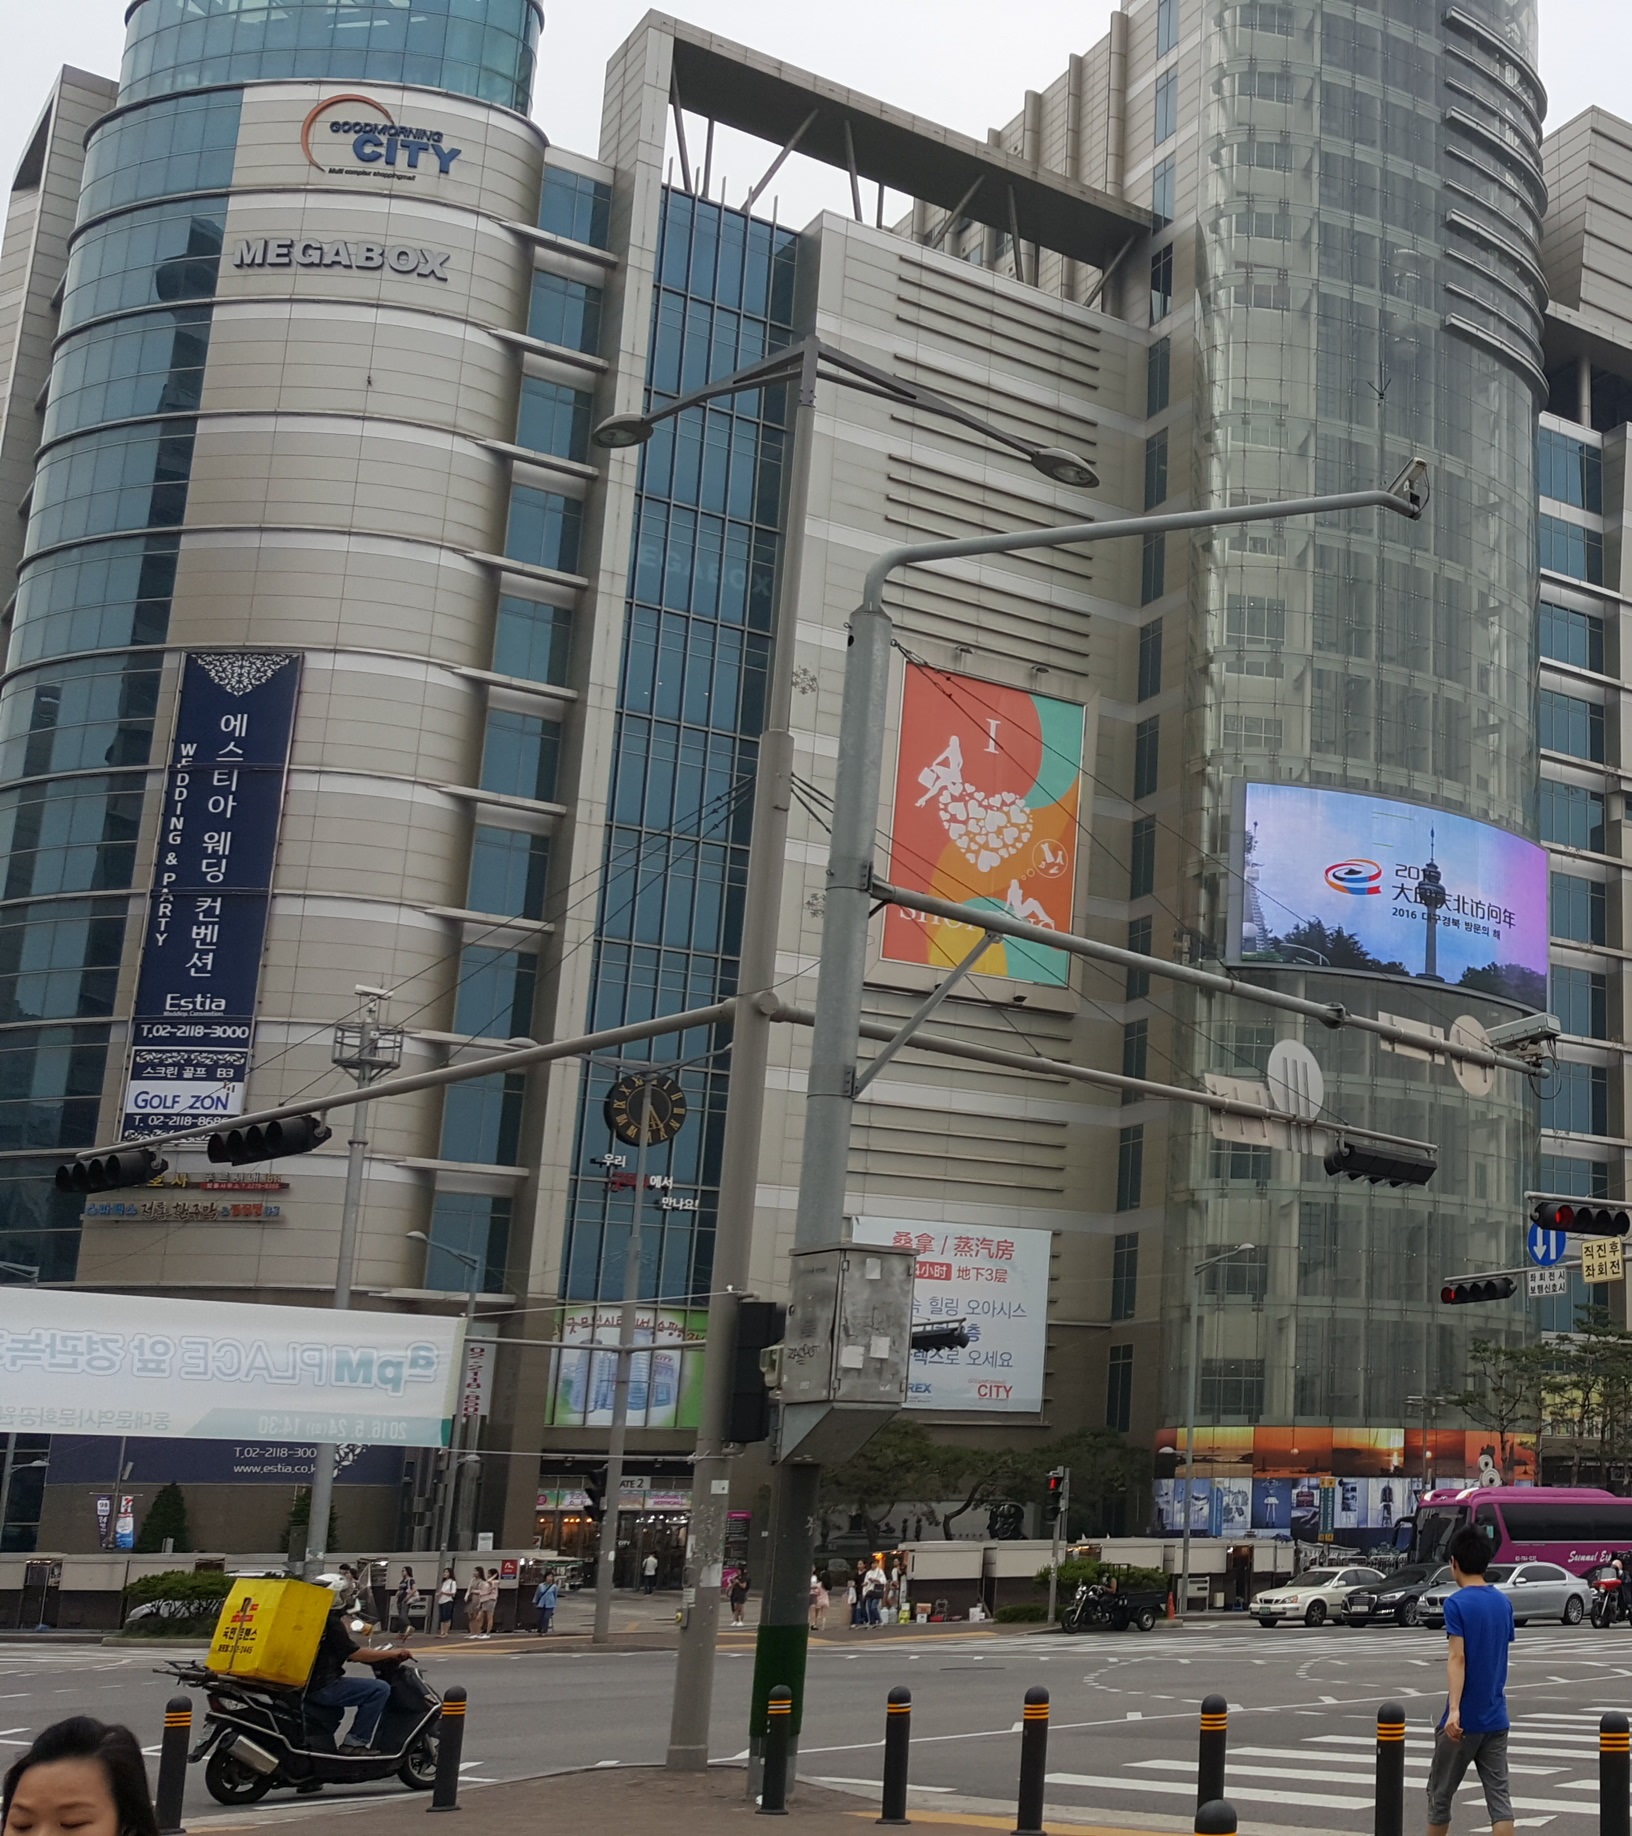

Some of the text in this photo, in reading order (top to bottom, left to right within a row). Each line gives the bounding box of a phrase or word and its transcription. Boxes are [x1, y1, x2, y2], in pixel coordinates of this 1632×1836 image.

[329, 120, 443, 143] GOODMORNING
[353, 133, 462, 174] CITY
[232, 237, 452, 282] MEGABOX
[984, 718, 1001, 754] I
[185, 713, 248, 977] 에스티아 웨딩 컨벤션
[155, 872, 177, 947] PARTY
[1392, 907, 1417, 920] 2016
[1464, 922, 1490, 937] 방문의
[165, 993, 226, 1011] Estia
[141, 1024, 250, 1039] T.02-2118-3000
[142, 1066, 234, 1079] 스크린 골프 B3
[134, 1090, 230, 1111] GOLF ZON
[602, 1153, 627, 1168] 우리
[649, 1175, 674, 1190] 에서
[661, 1196, 699, 1210] 만나요!
[892, 1231, 935, 1255] 桑拿
[954, 1235, 1015, 1260] 蒸汽房
[1583, 1242, 1620, 1259] 직진후
[914, 1263, 1008, 1284] 4小时 地下3层
[1585, 1261, 1621, 1278] 좌회전
[1530, 1282, 1566, 1295] 보행신호시
[929, 1296, 959, 1317] 힐링
[965, 1299, 1028, 1319] 오아시스
[966, 1351, 1013, 1368] 오세요
[977, 1384, 1013, 1399] CITY
[234, 1447, 318, 1459] T.02-2118-300
[619, 1480, 635, 1489] ATE
